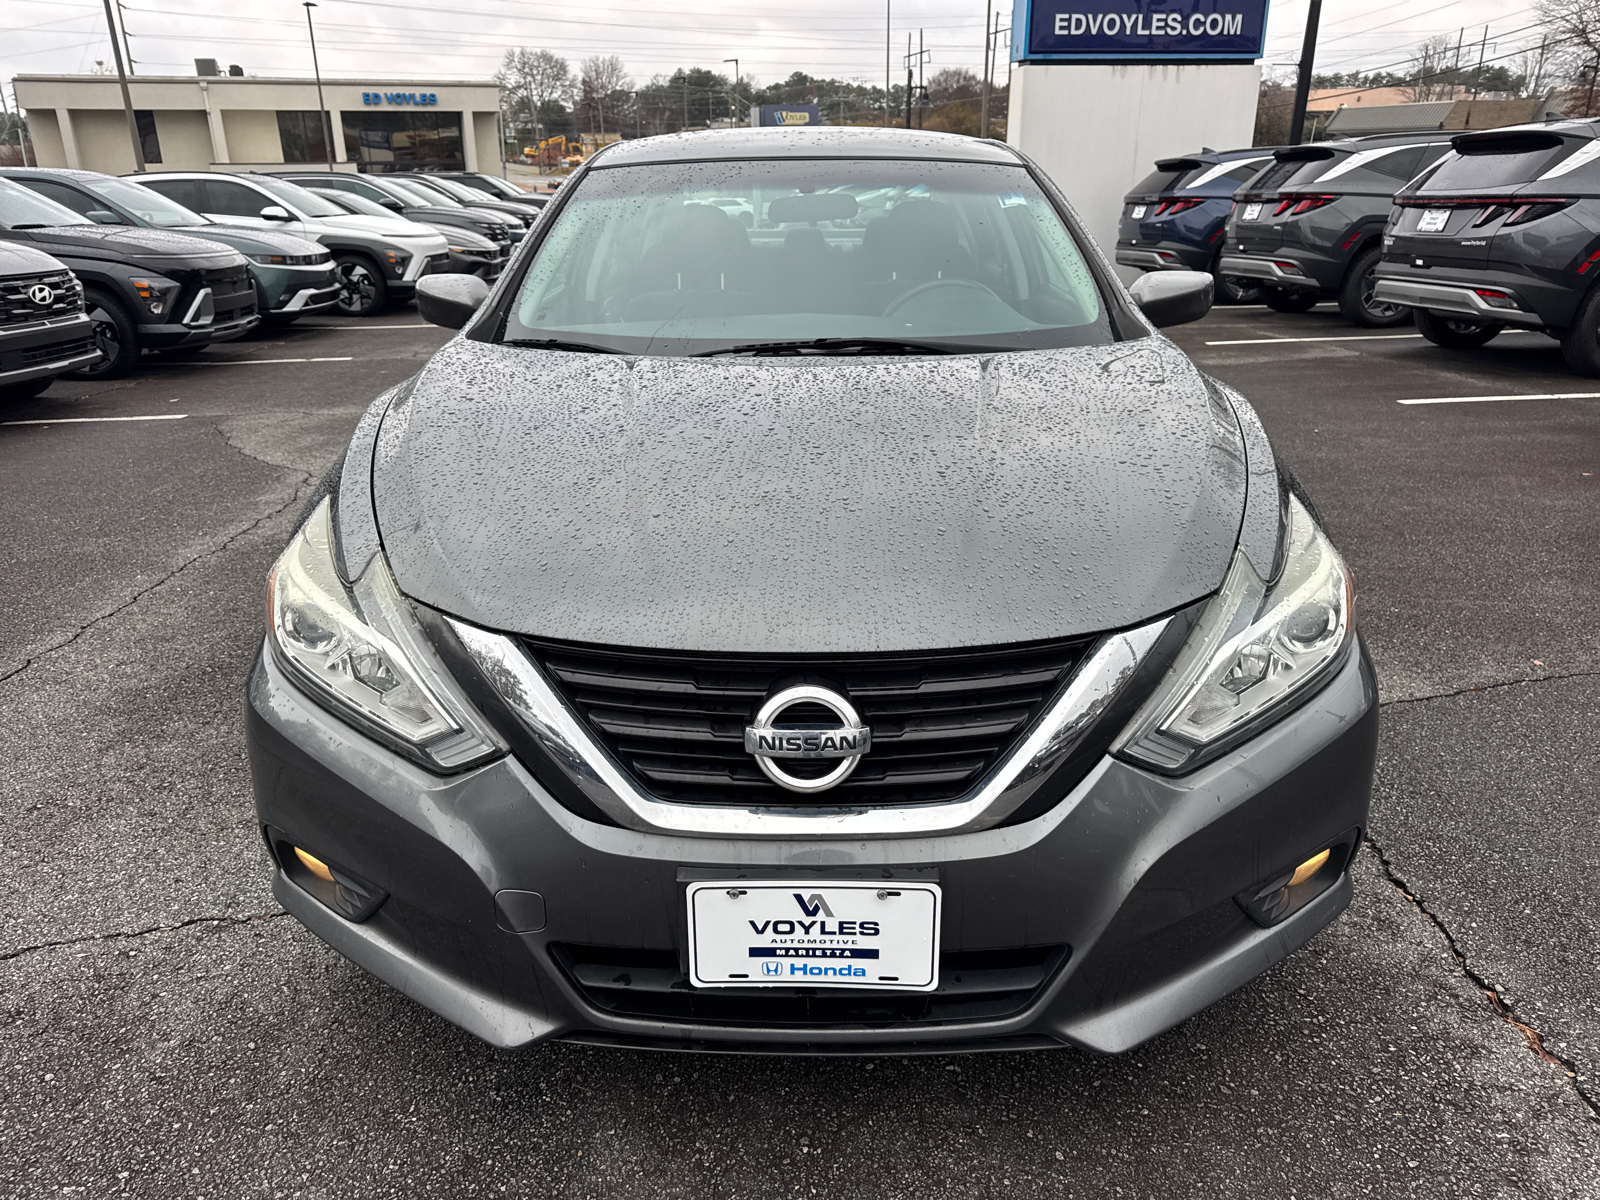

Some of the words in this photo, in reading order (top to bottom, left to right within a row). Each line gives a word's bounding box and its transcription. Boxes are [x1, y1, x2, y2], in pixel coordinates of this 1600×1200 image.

[1053, 13, 1243, 36] EDVOYLES.COM
[362, 92, 382, 105] ED
[384, 92, 438, 105] VOYLES
[758, 735, 858, 752] NISSAN
[748, 920, 880, 936] VOYLES
[776, 949, 852, 957] MARIETTA
[789, 963, 867, 977] Honda
